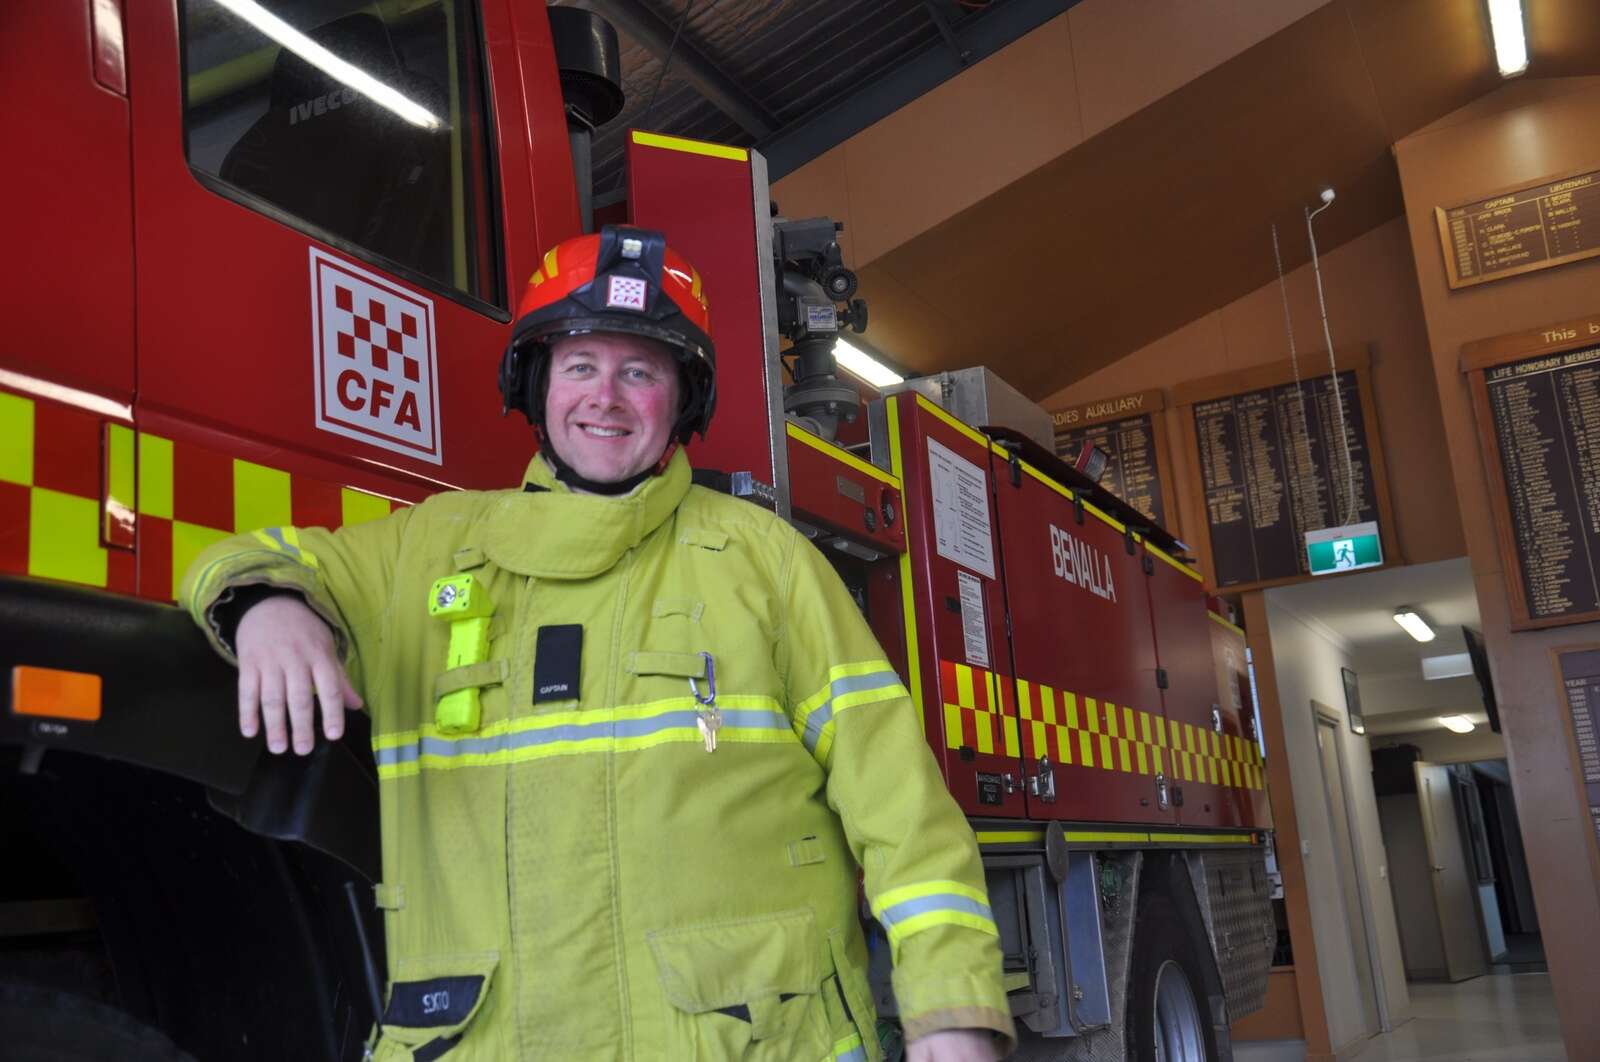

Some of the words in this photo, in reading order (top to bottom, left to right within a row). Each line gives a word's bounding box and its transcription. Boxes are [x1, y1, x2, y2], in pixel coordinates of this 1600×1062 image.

[1484, 196, 1515, 209] CAPTAIN
[613, 294, 640, 305] CFA
[1542, 328, 1577, 343] This
[1492, 366, 1513, 379] LIFE
[1515, 357, 1561, 373] HONORARY
[335, 369, 422, 432] CFA
[1052, 410, 1080, 426] ADIES
[1086, 395, 1144, 419] AUXILIARY
[1049, 523, 1118, 603] BENALLA
[540, 683, 569, 695] CAPTAIN
